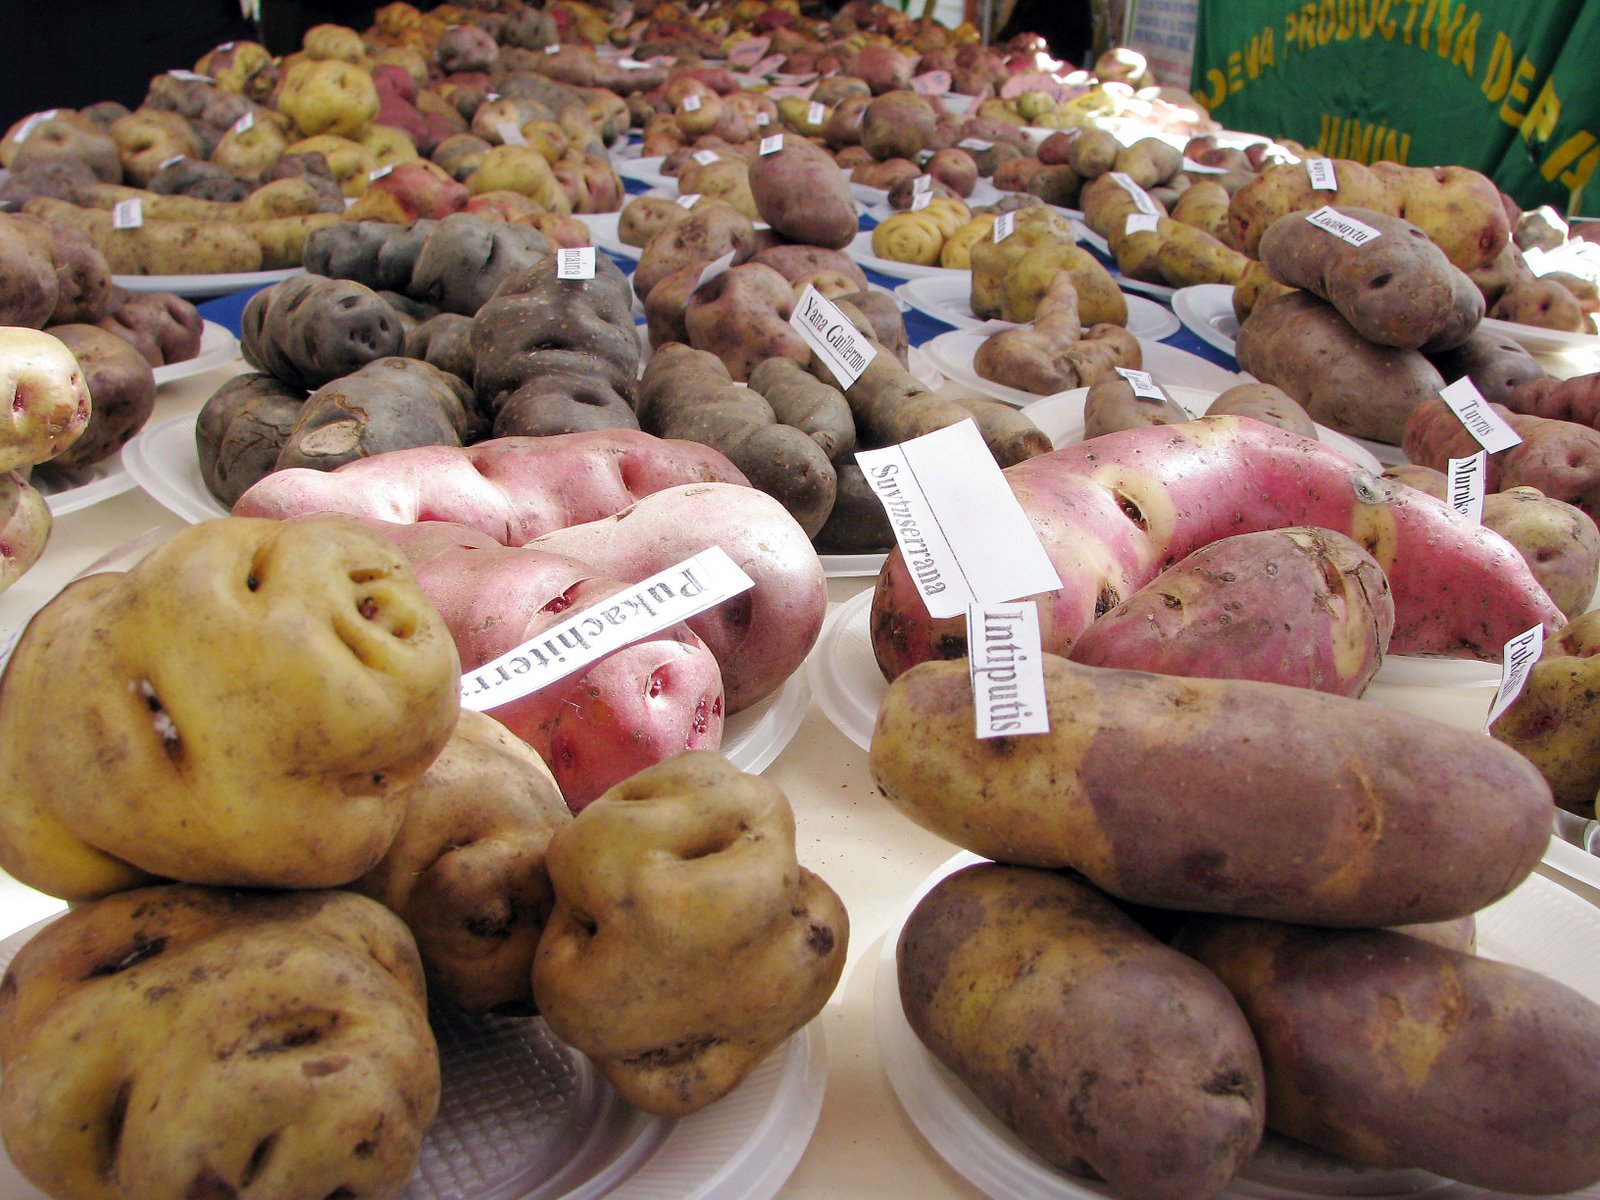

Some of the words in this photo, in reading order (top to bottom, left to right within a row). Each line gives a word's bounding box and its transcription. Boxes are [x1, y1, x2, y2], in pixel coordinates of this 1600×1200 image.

[1481, 31, 1537, 128] DE
[804, 295, 829, 333] Yana
[826, 324, 867, 373] Guillermo
[461, 566, 711, 697] Pukachiterr
[974, 610, 1033, 733] Intiputis
